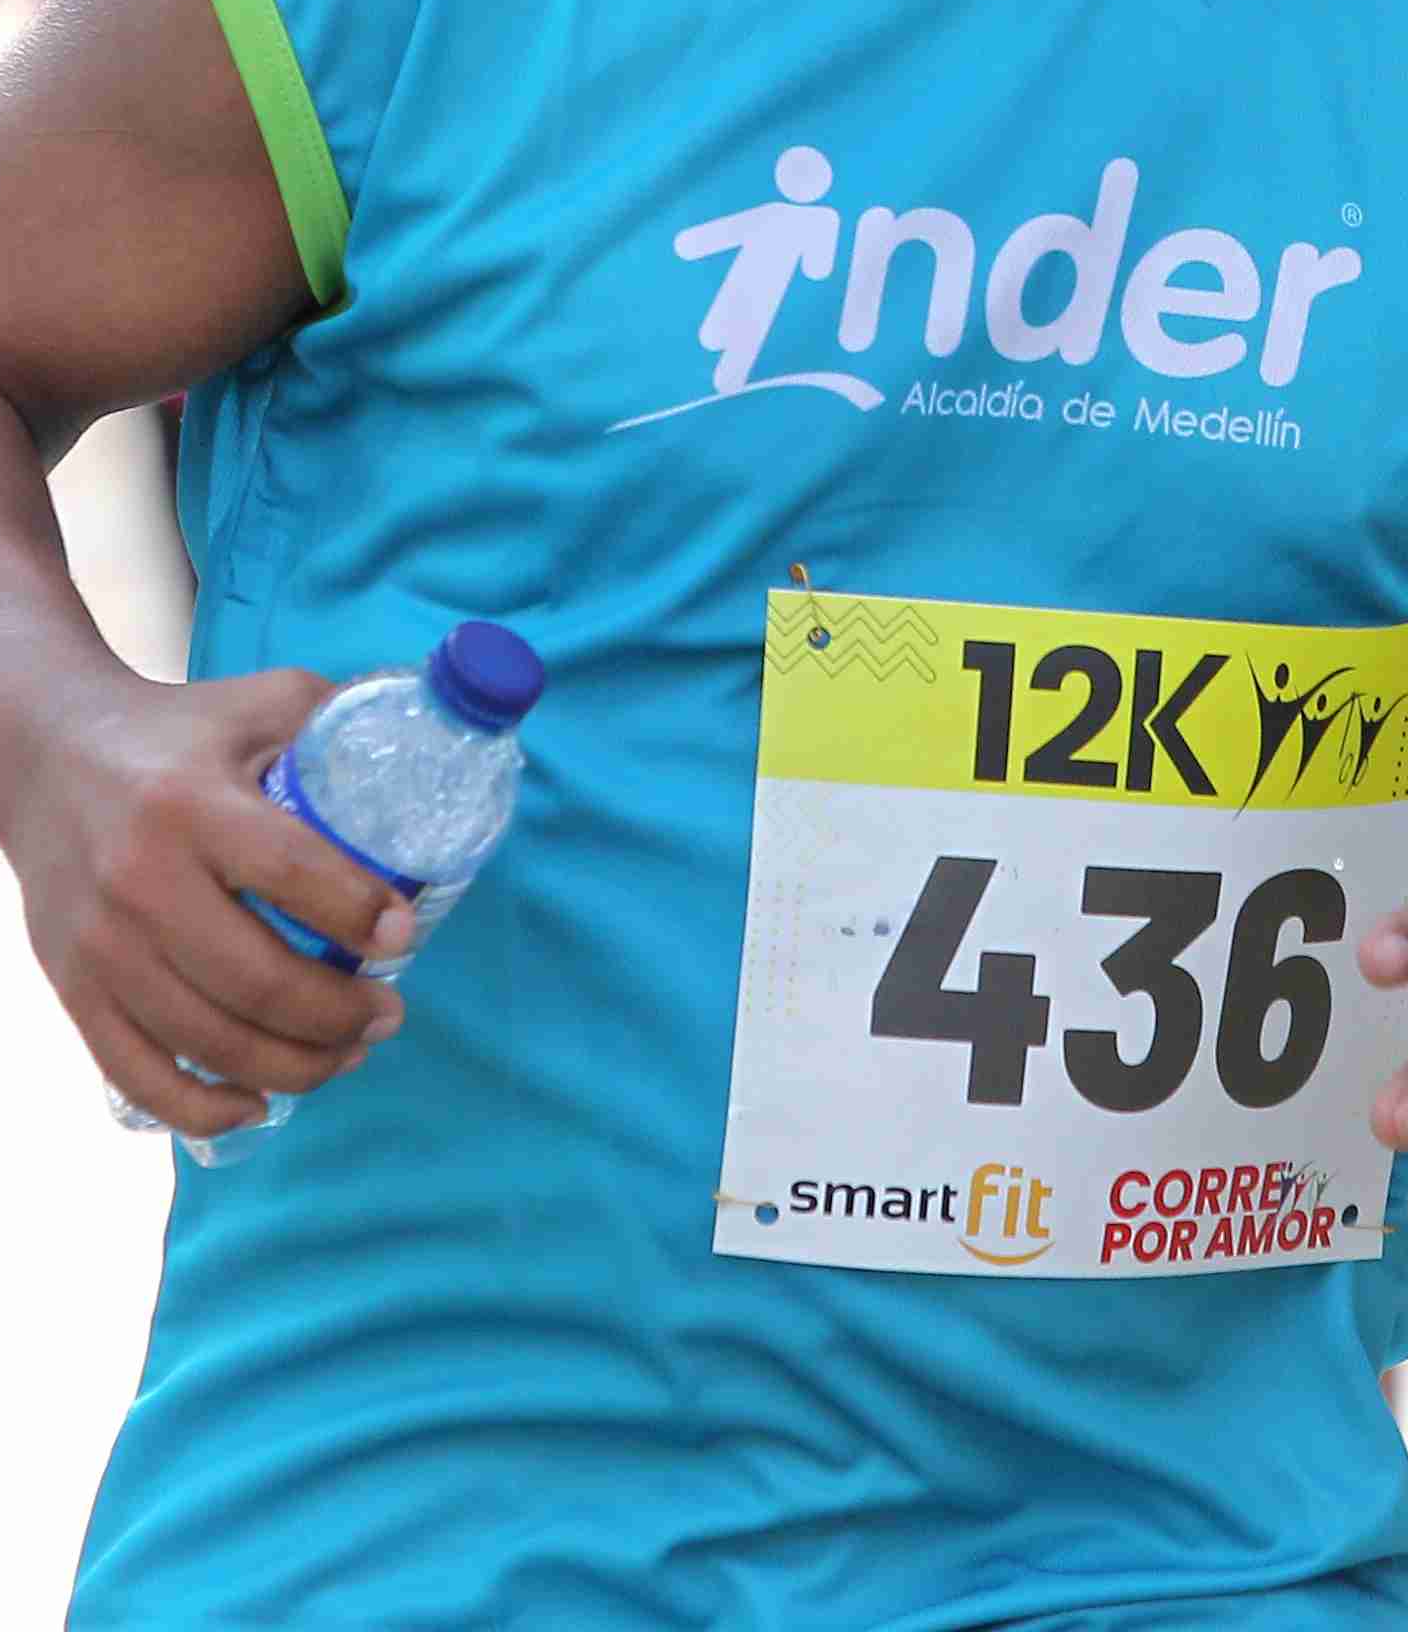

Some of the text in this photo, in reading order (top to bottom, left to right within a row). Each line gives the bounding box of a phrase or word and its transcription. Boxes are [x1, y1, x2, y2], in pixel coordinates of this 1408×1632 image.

[674, 146, 1362, 394] inder
[901, 380, 1303, 450] Alcaldía de Medellín
[962, 640, 1231, 797] 12K
[870, 855, 1347, 1114] 436
[1100, 1205, 1338, 1265] POR AMOR
